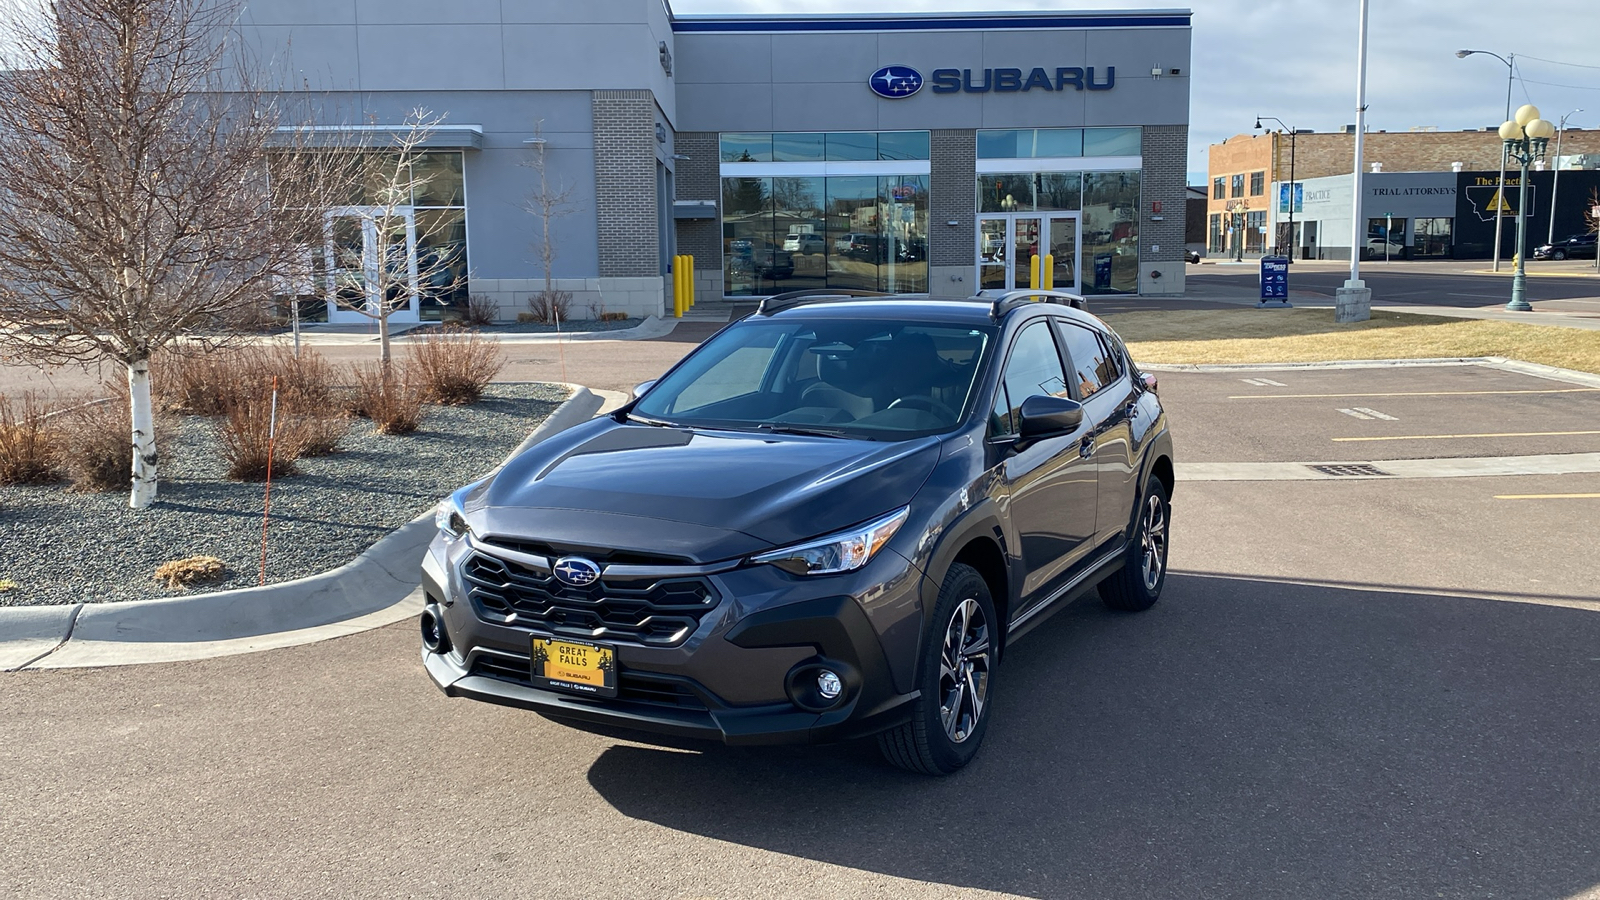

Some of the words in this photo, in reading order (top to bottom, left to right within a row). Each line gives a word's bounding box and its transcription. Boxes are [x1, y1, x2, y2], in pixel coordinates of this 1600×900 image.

[932, 66, 1115, 93] SUBARU
[1475, 177, 1493, 185] The
[1495, 177, 1531, 185] Pactie
[1305, 190, 1331, 200] PRACTICE
[1373, 188, 1400, 196] TRIAL
[1403, 187, 1456, 195] ATTORNEYS
[559, 646, 587, 657] GREAT
[560, 655, 587, 666] FALLS
